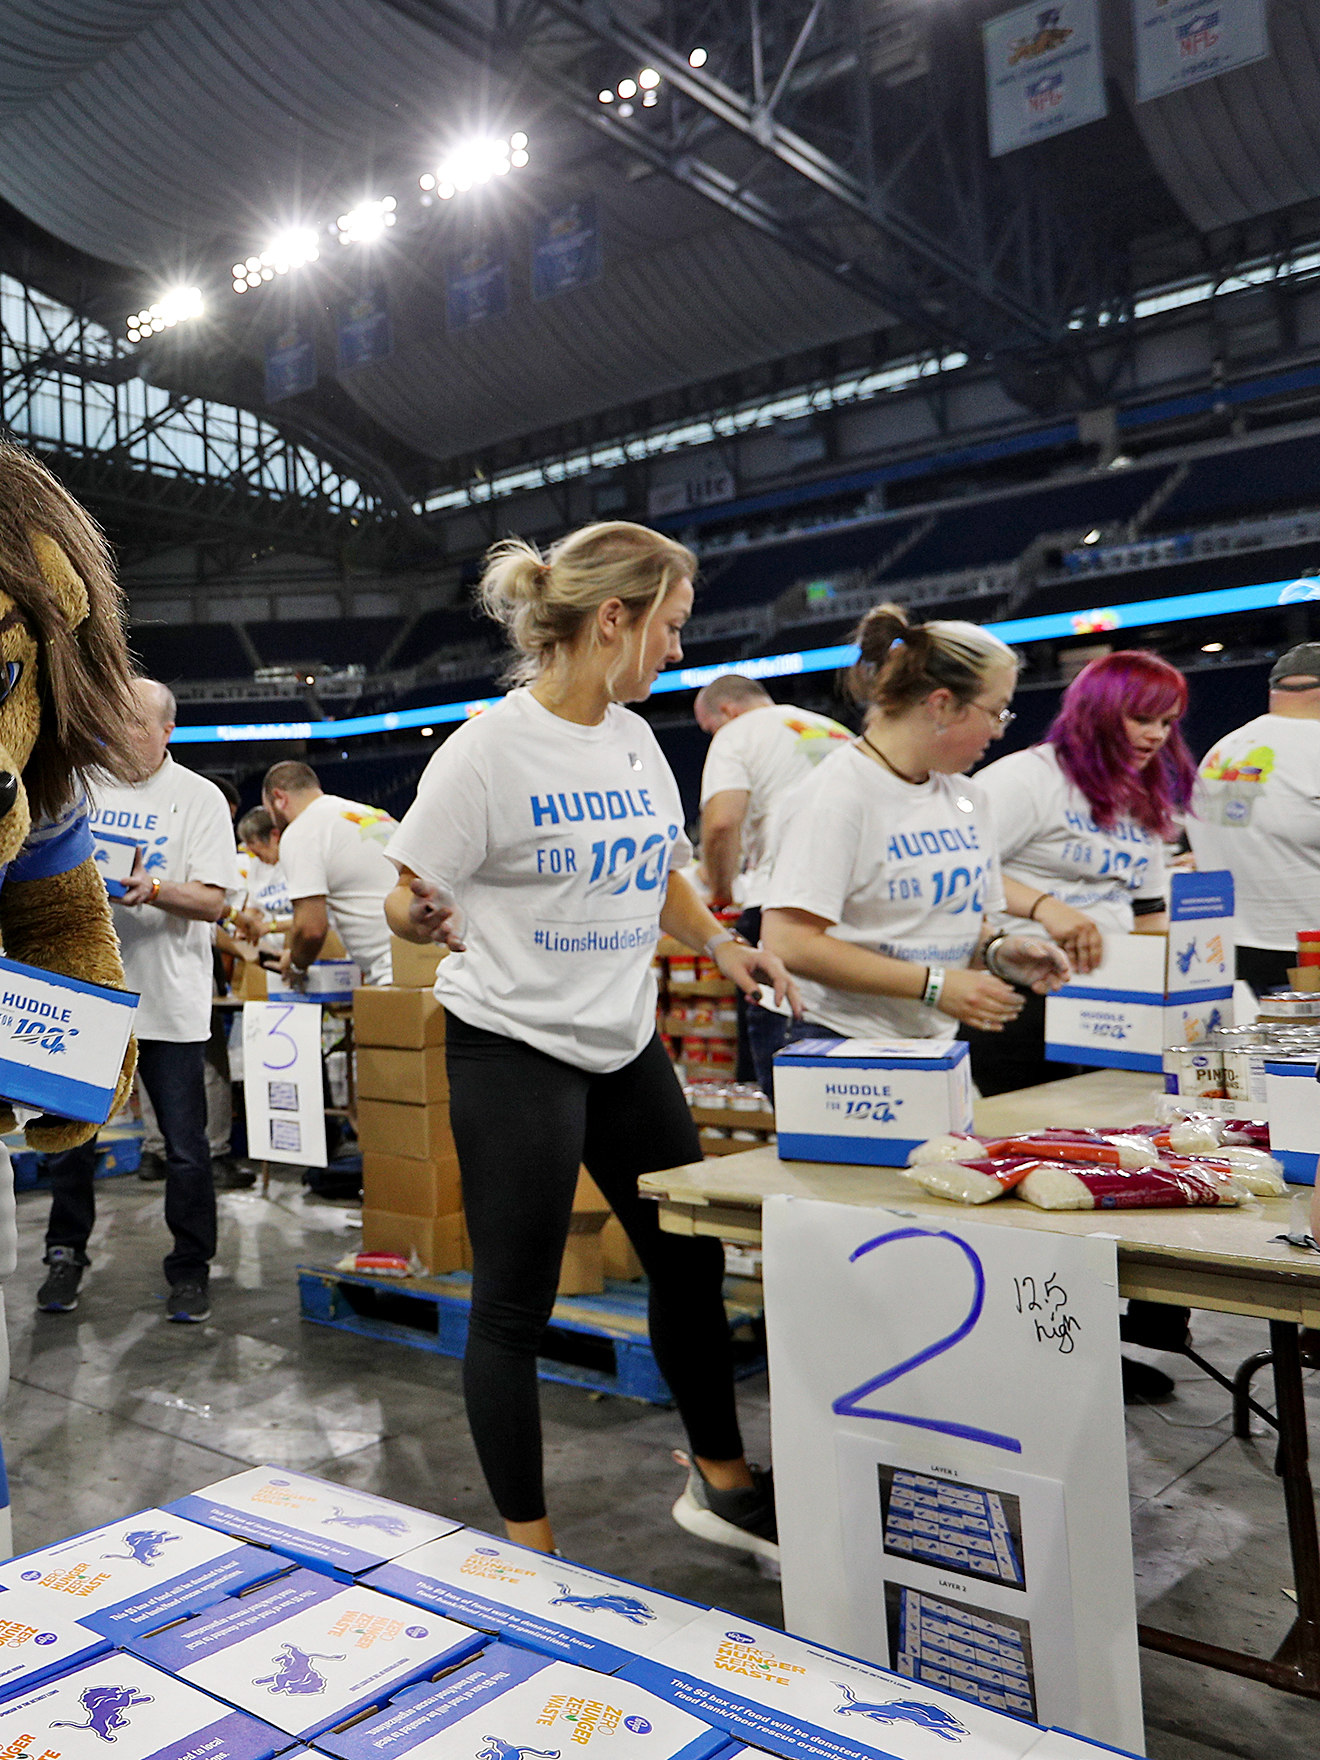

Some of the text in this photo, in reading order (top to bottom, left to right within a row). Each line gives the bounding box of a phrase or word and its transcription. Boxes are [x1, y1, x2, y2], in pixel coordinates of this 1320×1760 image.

[87, 809, 159, 831] UDDLE
[530, 789, 656, 827] HUDDLE
[537, 832, 668, 895] FOR 100
[888, 877, 923, 901] FOR
[2, 991, 72, 1023] HUDDLE
[263, 1004, 298, 1070] 3
[825, 1084, 891, 1097] HUDDLE
[831, 1226, 1022, 1454] 2
[1034, 1312, 1081, 1354] high
[930, 1464, 953, 1475] LAYER
[38, 1569, 66, 1587] ZERO
[50, 1562, 92, 1590] HUNGER
[460, 1567, 520, 1584] WASTE
[466, 1558, 536, 1576] HUNGER
[76, 1572, 112, 1596] WASTE
[938, 1579, 961, 1591] LAYER
[7, 1627, 39, 1648] ZERO
[720, 1640, 775, 1658] ZERO
[713, 1661, 790, 1686] WASTE
[715, 1654, 772, 1673] ZERO
[717, 1647, 806, 1675] HUNGER
[536, 1694, 567, 1726] WASTE
[560, 1696, 585, 1721] ZERO
[598, 1705, 623, 1735] ZERO
[669, 1679, 693, 1691] This
[692, 1688, 709, 1698] $5
[707, 1694, 729, 1706] box
[729, 1703, 743, 1711] of
[742, 1708, 770, 1722] food
[769, 1719, 795, 1732] will
[793, 1728, 809, 1738] be
[809, 1735, 861, 1759] donated
[570, 1699, 604, 1745] HUNGER
[674, 1690, 847, 1760] food bank/food rescue organiz
[192, 1747, 205, 1758] to
[201, 1737, 225, 1751] local
